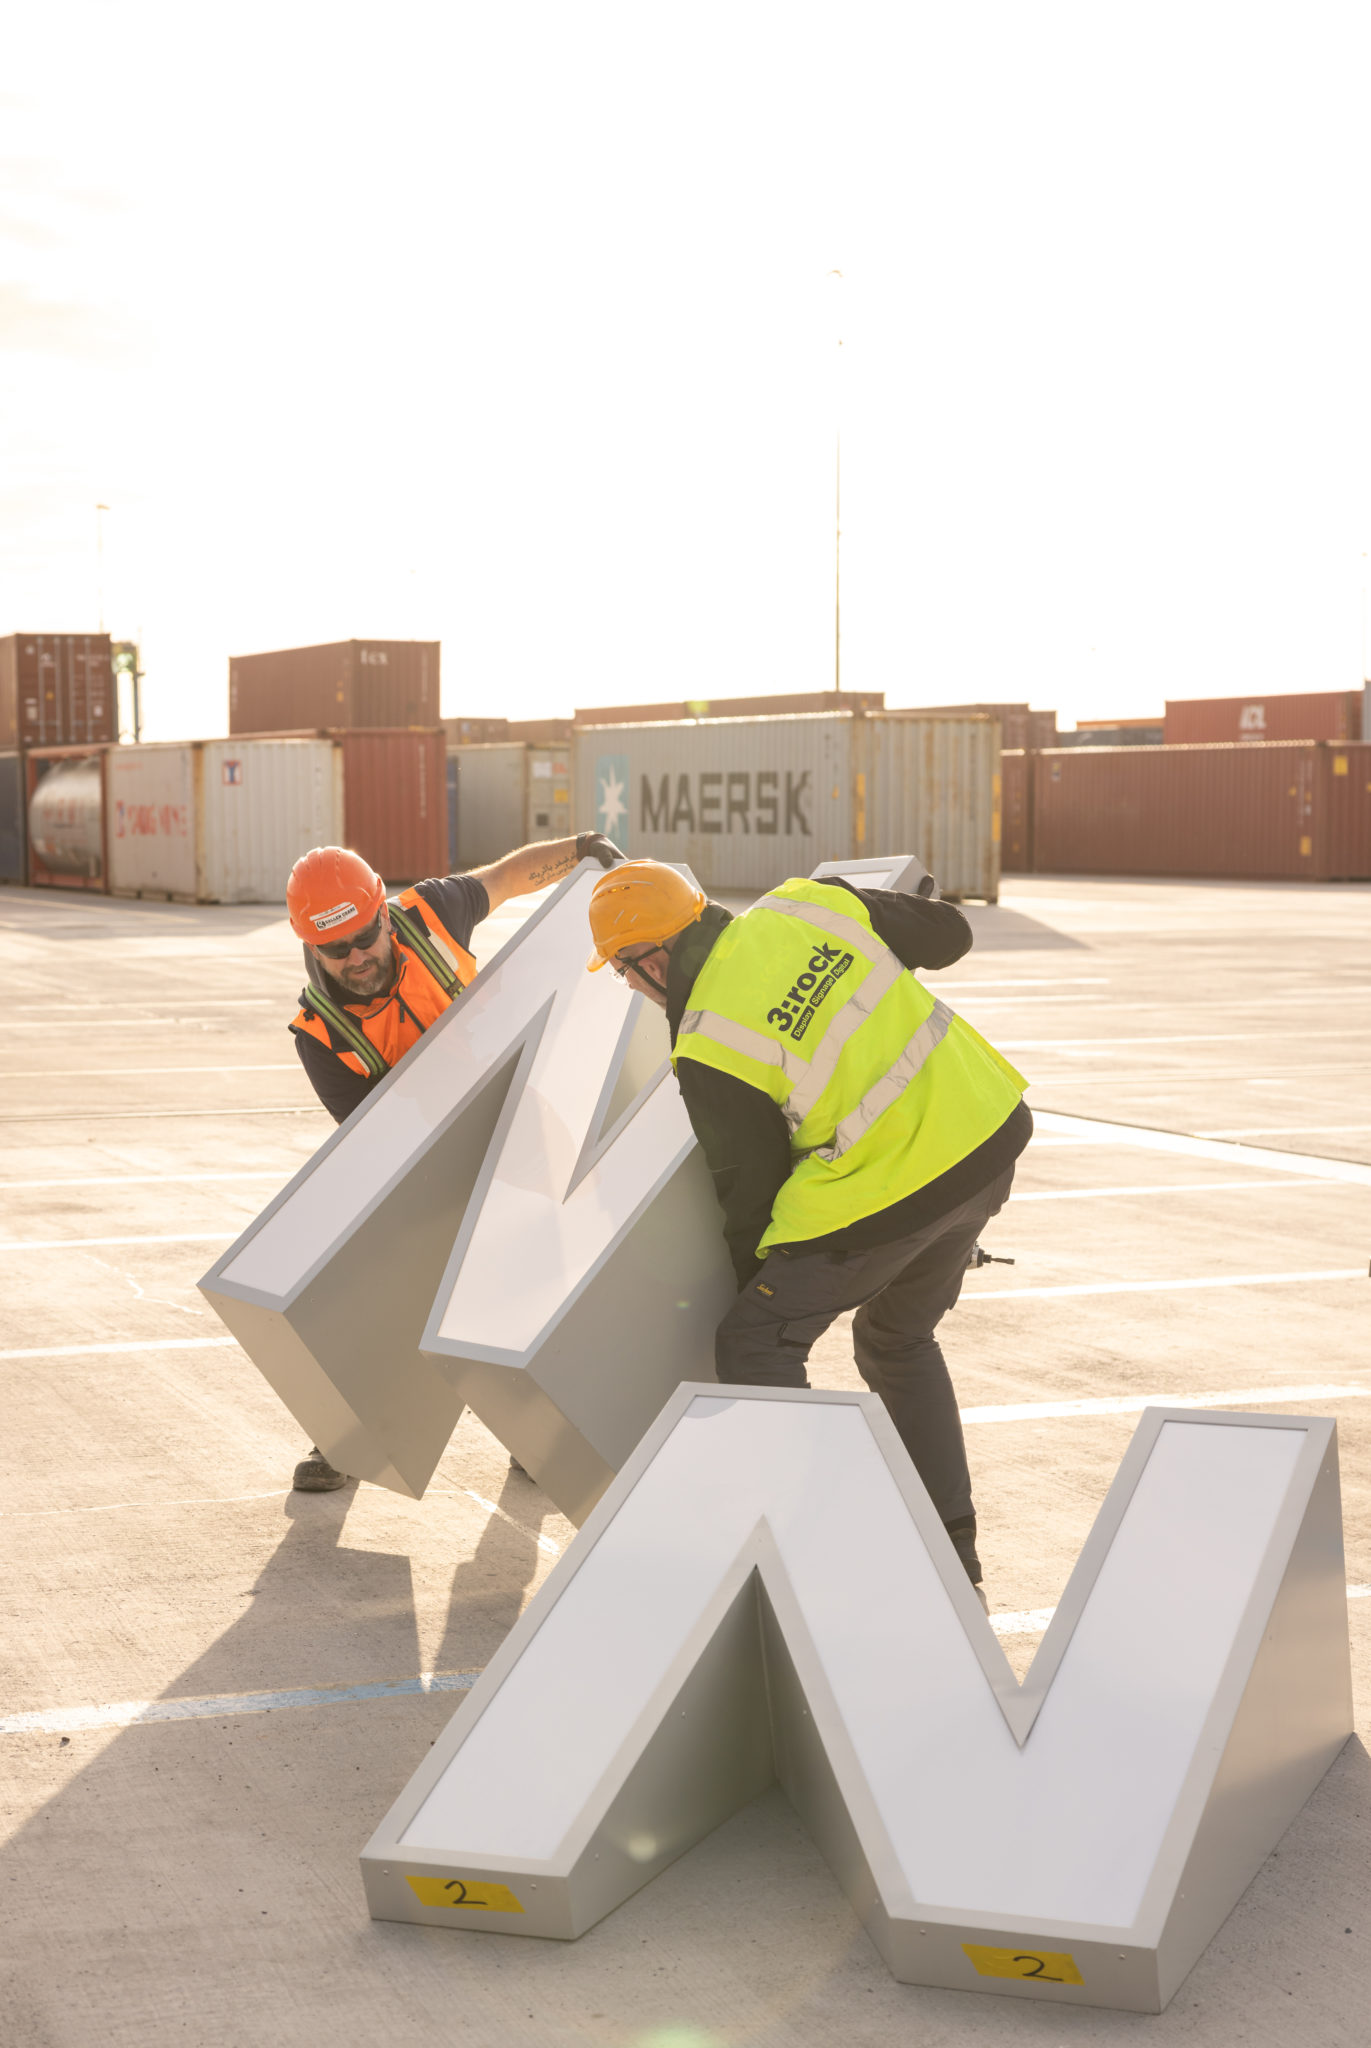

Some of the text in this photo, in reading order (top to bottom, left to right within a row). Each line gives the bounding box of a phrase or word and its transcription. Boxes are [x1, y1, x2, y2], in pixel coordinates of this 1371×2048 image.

[641, 770, 812, 836] MAERSK
[767, 942, 842, 1032] 3:rock
[793, 957, 852, 1038] Display Signage Digital
[444, 1880, 489, 1906] 2
[1012, 1955, 1064, 1982] 2
